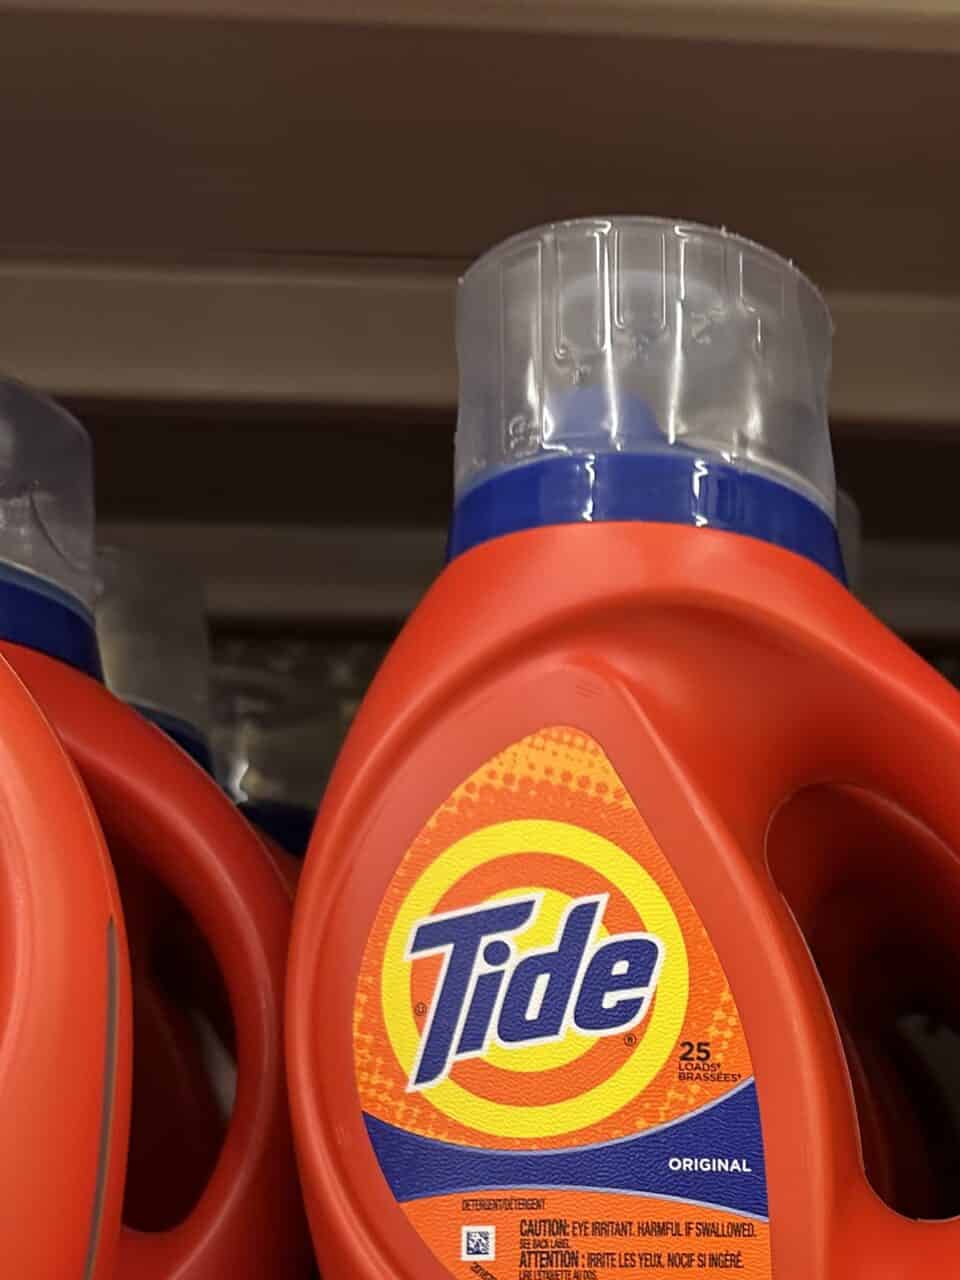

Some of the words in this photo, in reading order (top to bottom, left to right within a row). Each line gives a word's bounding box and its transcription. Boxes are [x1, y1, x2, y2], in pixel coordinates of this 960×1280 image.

[404, 893, 666, 1093] Tide
[680, 1041, 710, 1061] 25
[668, 1158, 752, 1172] ORIGINAL
[519, 1219, 569, 1237] CAUTION:
[572, 1221, 589, 1236] EYE
[638, 1222, 682, 1237] HARMFUL
[685, 1222, 694, 1236] IF
[619, 1253, 636, 1268] LES
